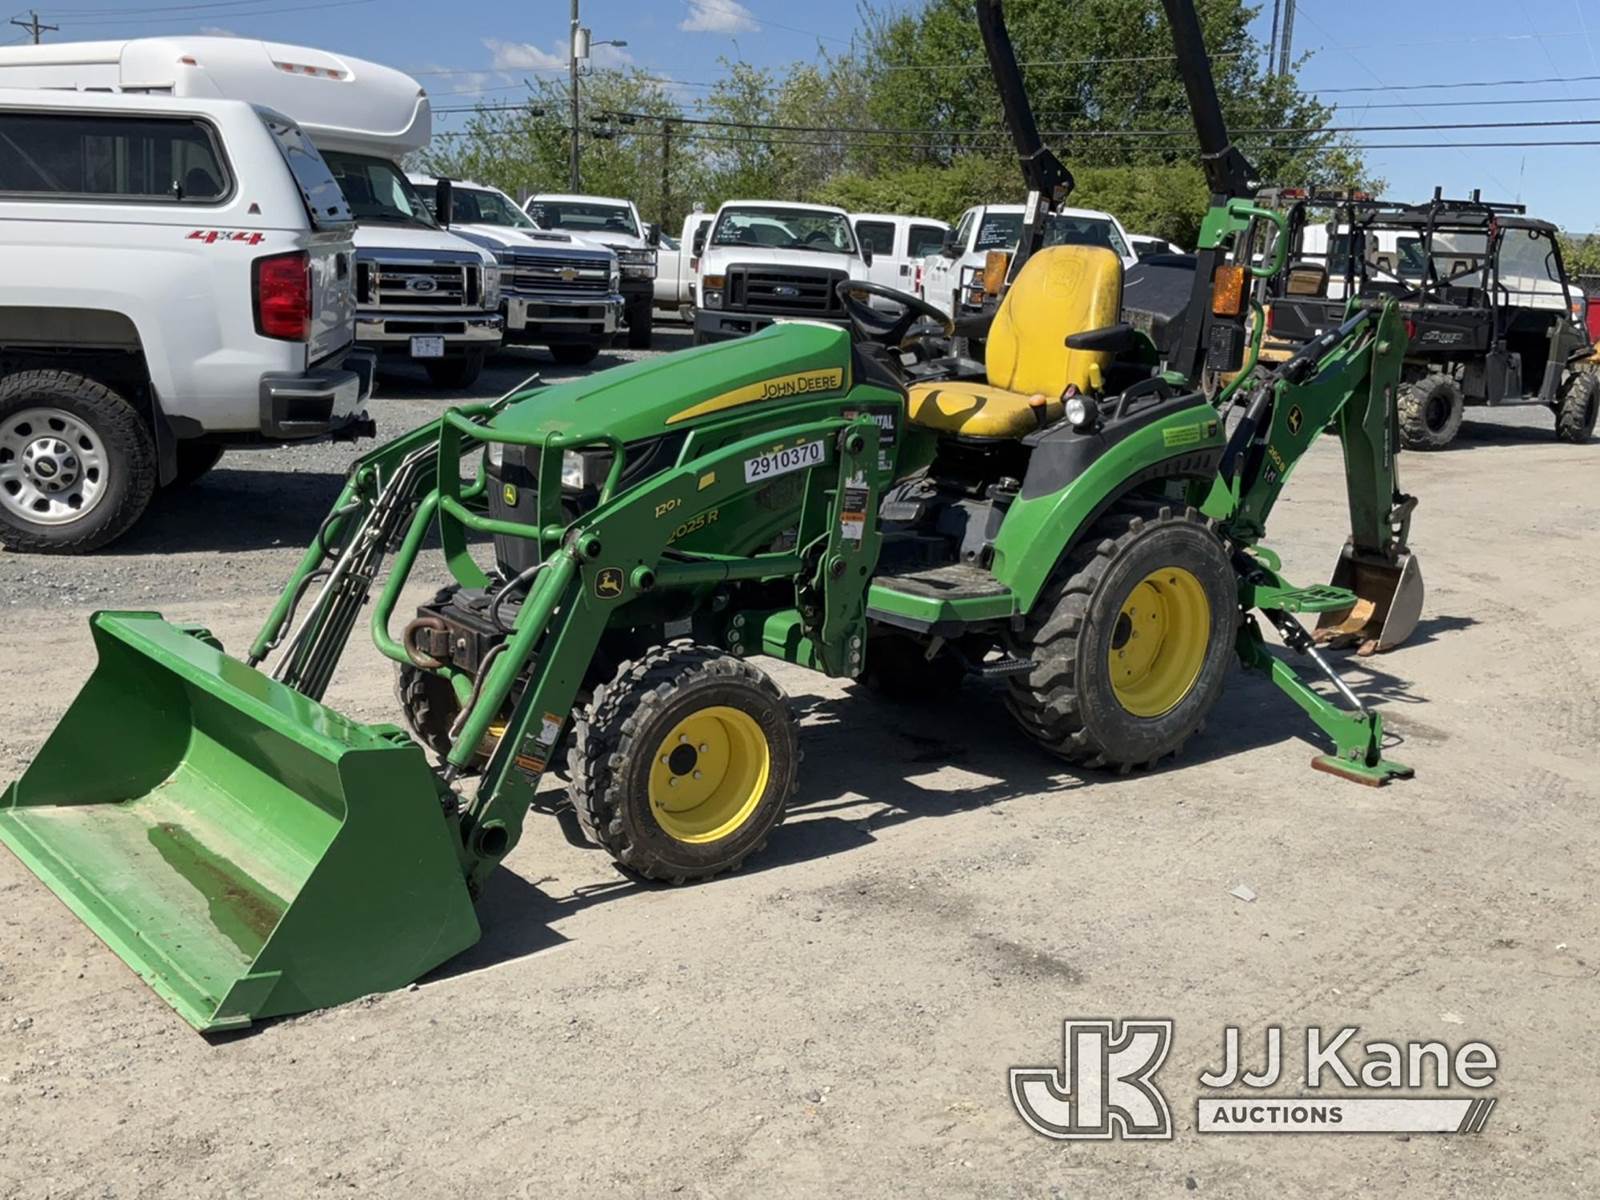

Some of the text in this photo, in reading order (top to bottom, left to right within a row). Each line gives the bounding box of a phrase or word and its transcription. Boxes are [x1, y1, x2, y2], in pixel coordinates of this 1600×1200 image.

[761, 375, 838, 400] JOHN DEERE
[751, 443, 820, 477] 2910370
